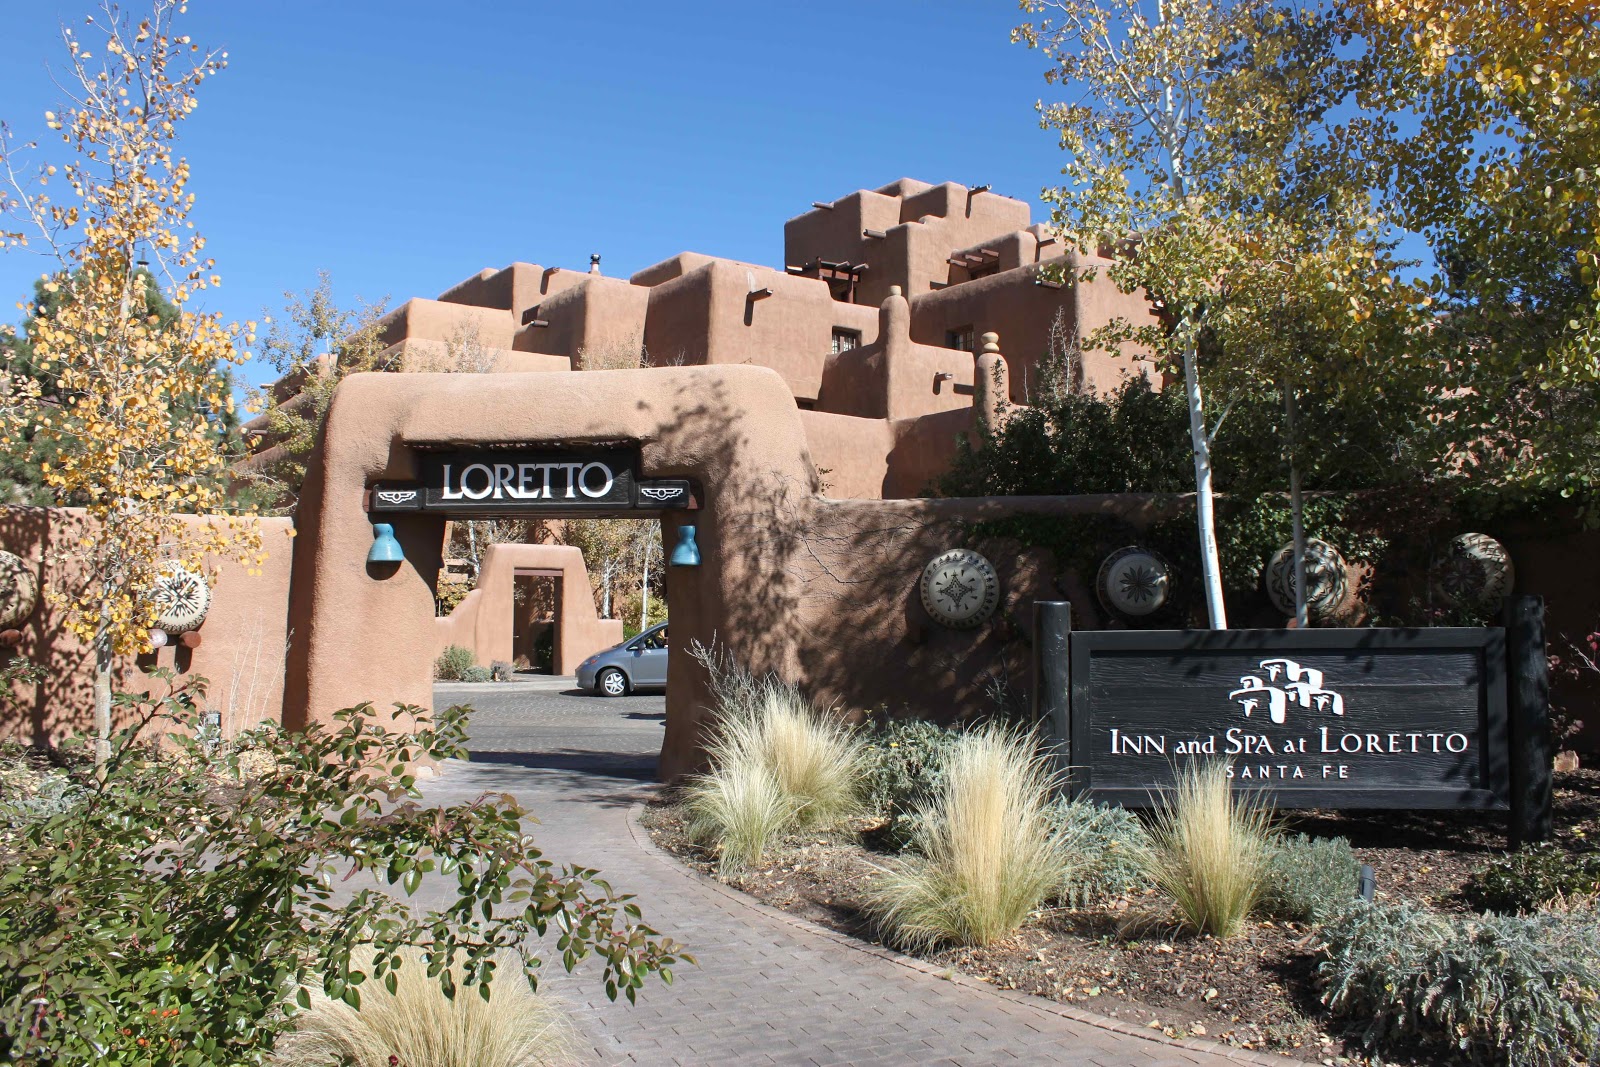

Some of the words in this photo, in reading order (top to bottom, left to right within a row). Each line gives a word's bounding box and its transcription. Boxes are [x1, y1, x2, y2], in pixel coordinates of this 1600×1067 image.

[441, 461, 614, 500] LORETTO
[1109, 728, 1166, 755] INN
[1175, 735, 1215, 755] and
[1225, 727, 1272, 755] SPA
[1283, 738, 1307, 753] at
[1319, 727, 1468, 754] LORETTO
[1226, 765, 1304, 779] SANTA
[1322, 765, 1349, 779] FE
